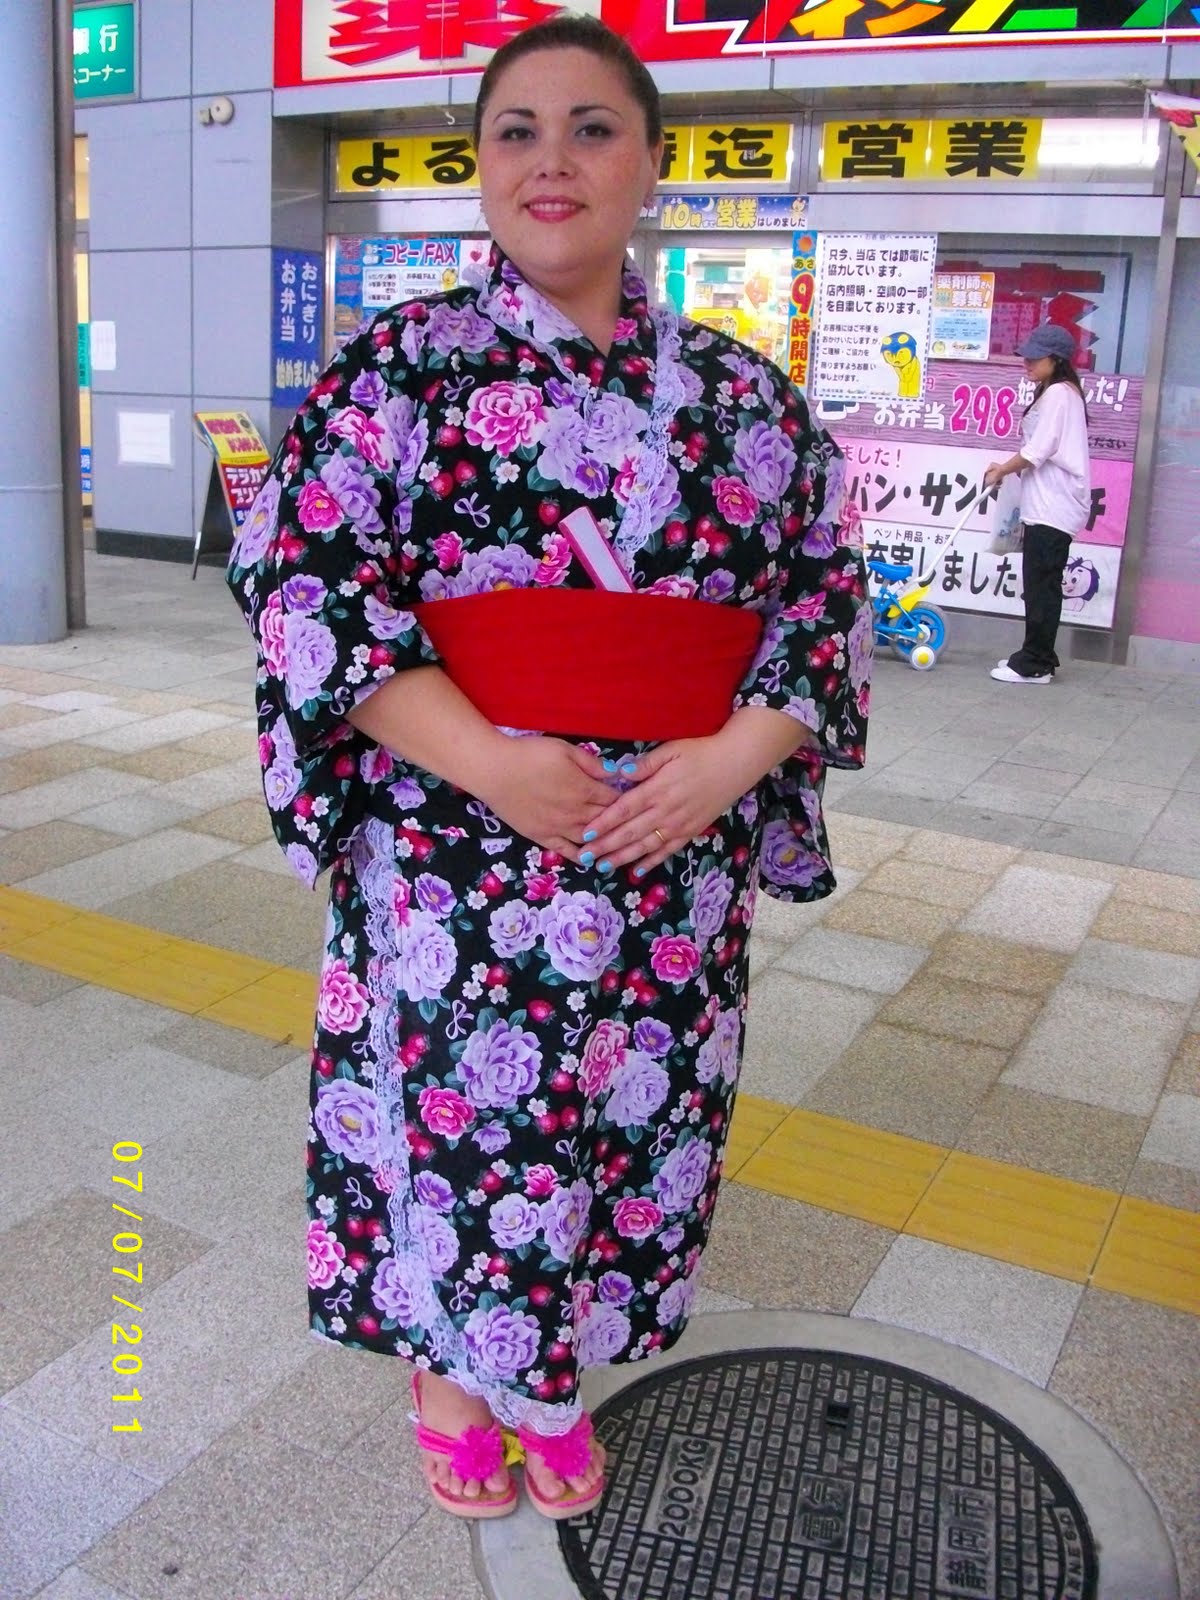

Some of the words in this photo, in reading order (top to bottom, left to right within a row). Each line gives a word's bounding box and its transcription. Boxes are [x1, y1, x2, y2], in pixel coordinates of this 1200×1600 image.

[280, 259, 297, 343] お弁当
[301, 261, 319, 344] おにぎり
[873, 401, 946, 431] お弁当
[950, 383, 1018, 438] 298
[658, 1437, 711, 1538] 2000KG
